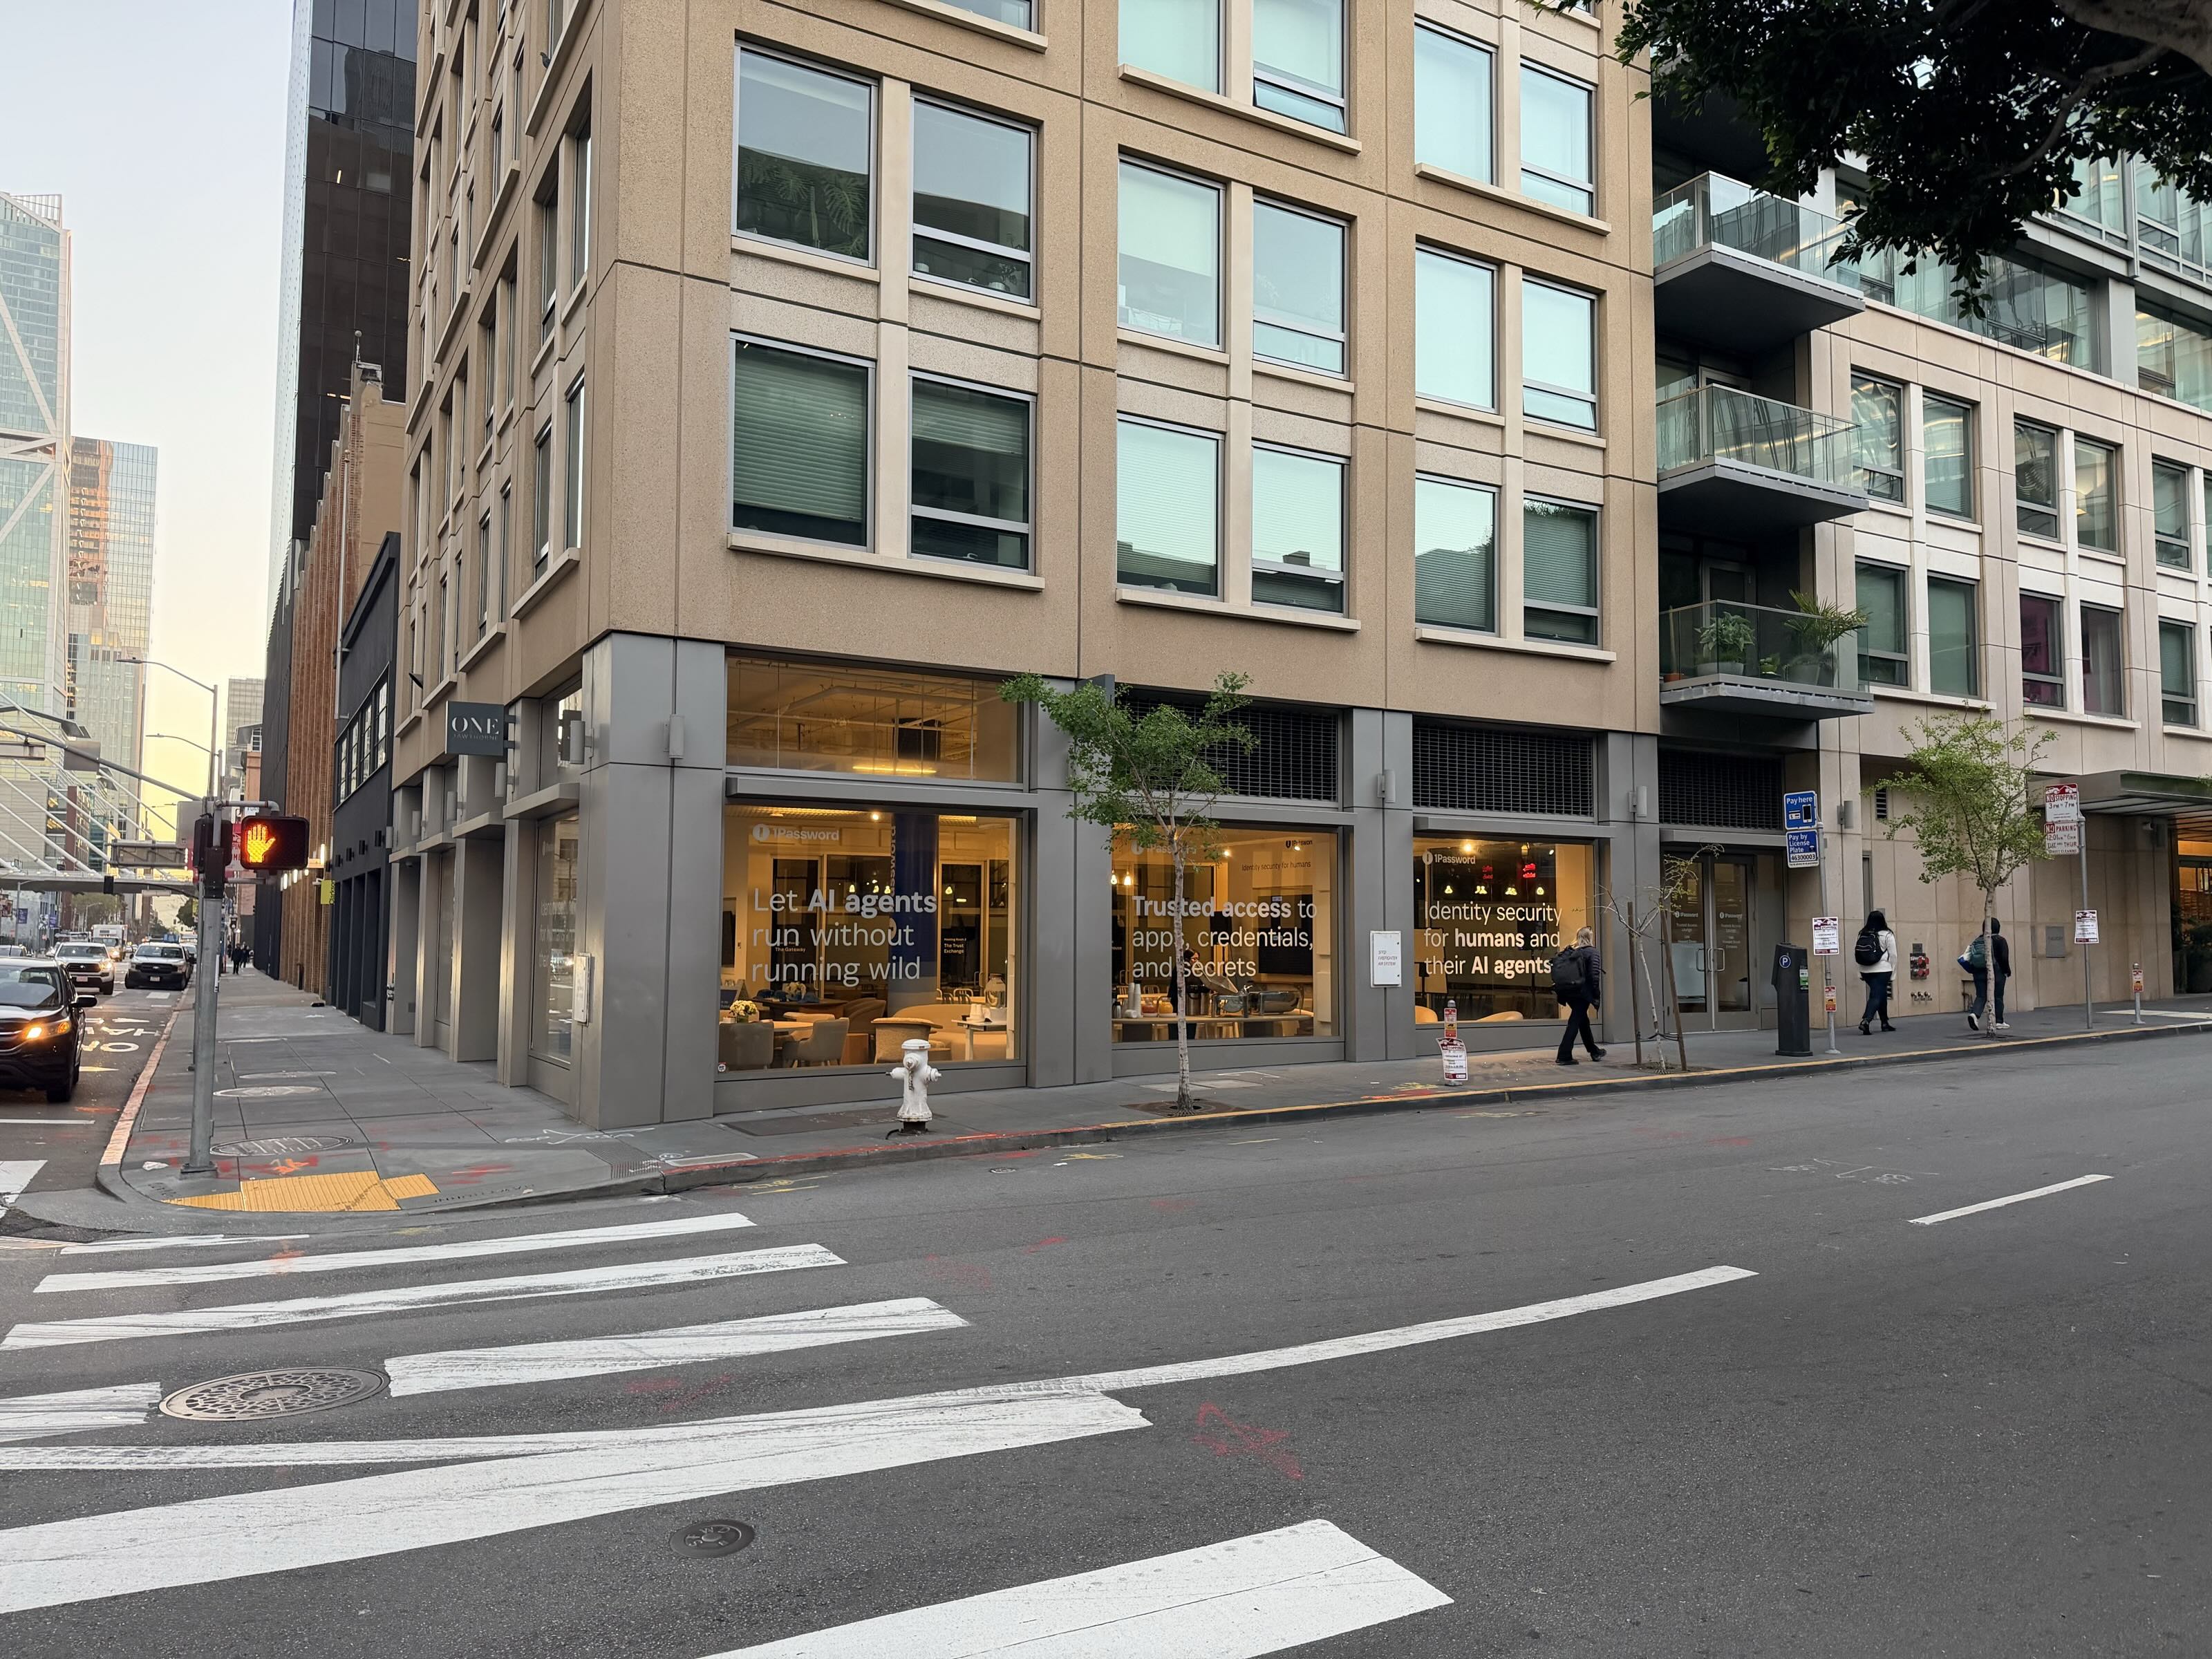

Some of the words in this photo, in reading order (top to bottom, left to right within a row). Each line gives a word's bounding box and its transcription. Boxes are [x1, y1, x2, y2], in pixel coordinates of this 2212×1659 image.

[451, 717, 499, 735] ONE
[2046, 794, 2054, 803] NO
[773, 827, 839, 841] 1Password
[1434, 854, 1476, 864] 1Password
[754, 888, 798, 912] Let
[807, 889, 834, 912] AI
[845, 891, 937, 919] agents
[1132, 896, 1215, 917] Trusted
[1222, 901, 1291, 917] access
[1297, 900, 1317, 919] to
[1425, 901, 1491, 926] Identity
[1497, 903, 1562, 926] security
[753, 928, 799, 946] run
[810, 922, 915, 946] without
[1198, 926, 1313, 950] credentials,
[1424, 928, 1449, 947] for
[1455, 928, 1524, 947] humans
[1530, 932, 1560, 948] and
[752, 956, 861, 987] running
[869, 955, 920, 980] wild
[1132, 956, 1172, 977] and
[1183, 957, 1257, 977] secrets
[1424, 955, 1465, 975] their
[1471, 956, 1488, 974] AI
[1494, 957, 1552, 980] agents
[1782, 957, 1788, 966] P
